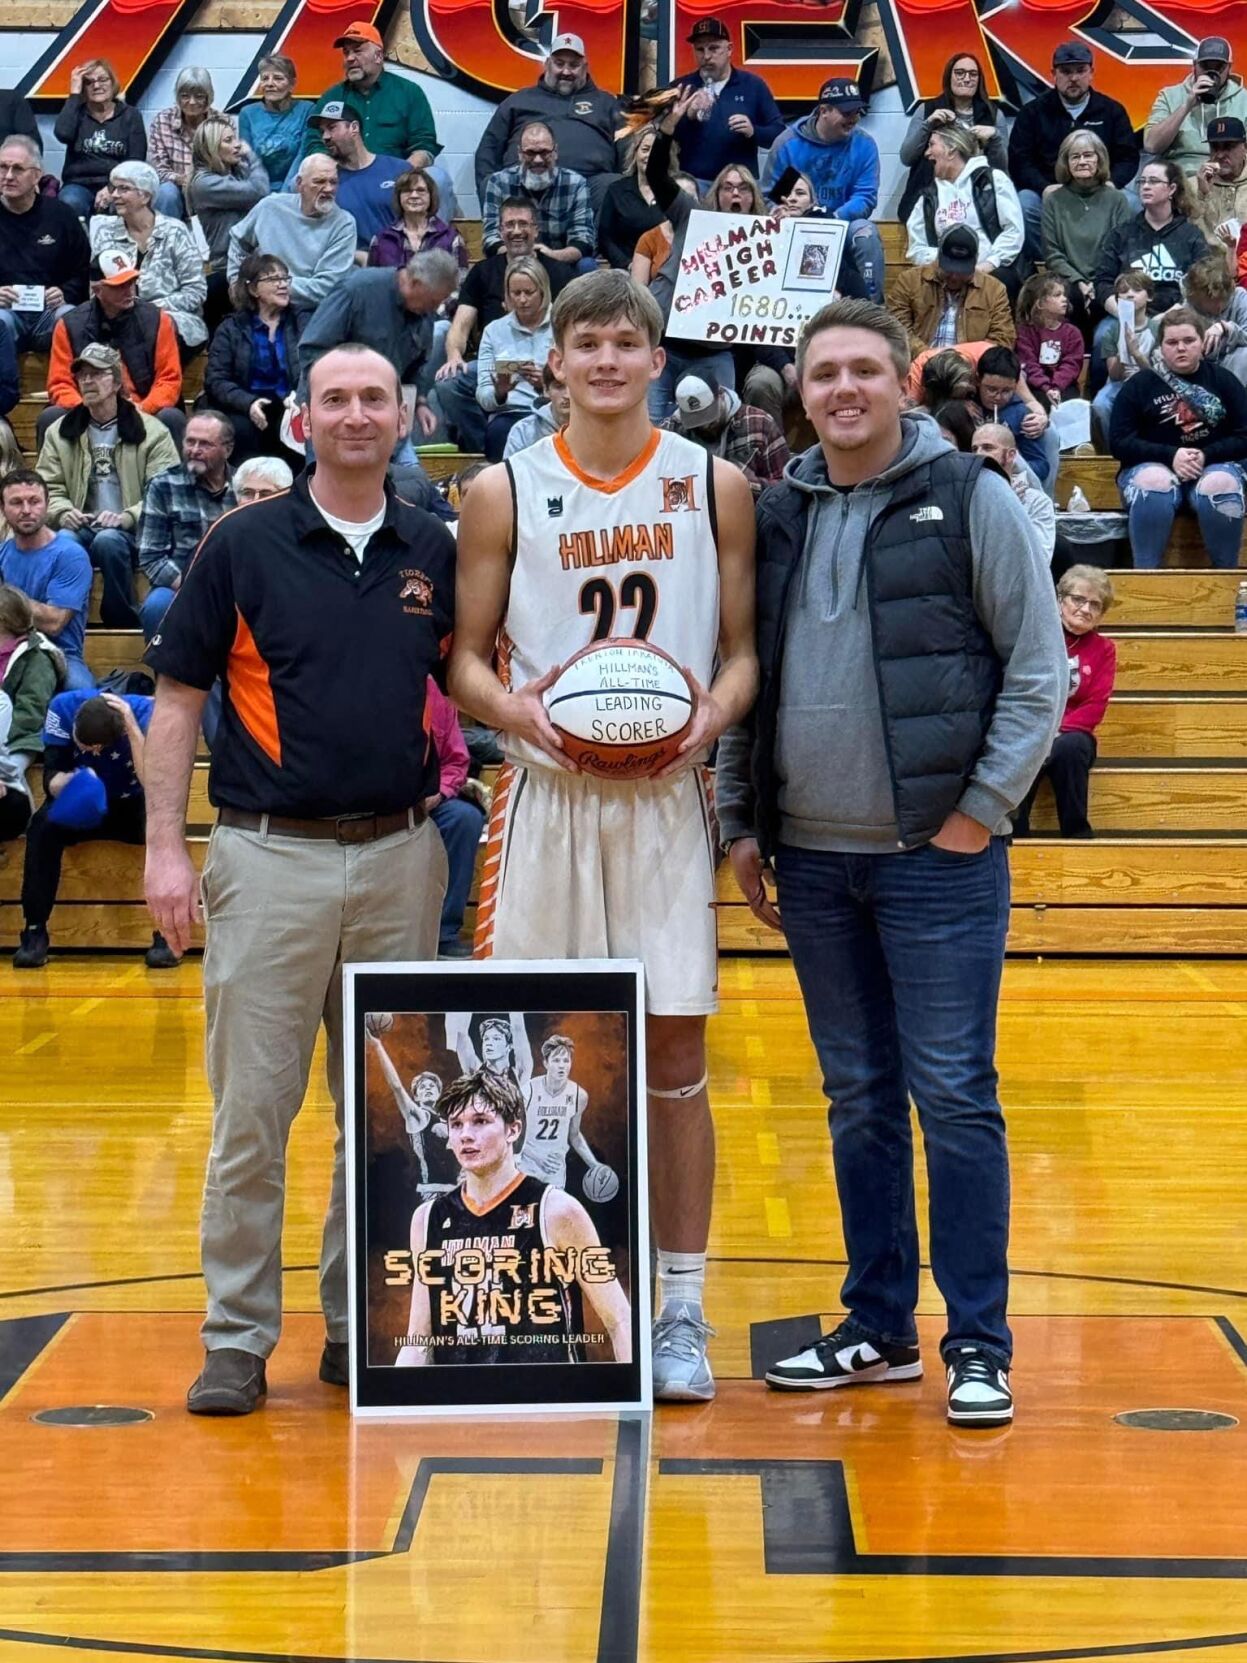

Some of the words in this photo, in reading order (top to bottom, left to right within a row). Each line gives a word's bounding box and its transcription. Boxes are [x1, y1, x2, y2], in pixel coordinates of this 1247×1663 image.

[681, 216, 783, 275] HILLMAN
[703, 239, 773, 280] HIGH
[674, 260, 777, 313] CAREER
[706, 322, 796, 345] POINTS
[559, 523, 674, 571] HILLMAN
[599, 663, 659, 677] HILLMAN'S
[599, 676, 662, 689] ALL-TIME
[595, 696, 662, 711] LEADING
[591, 718, 668, 742] SCORER
[535, 1118, 560, 1140] 22
[383, 1246, 616, 1287] SCORING
[439, 1287, 562, 1326] KING
[394, 1335, 455, 1347] HILLMAN'S
[456, 1334, 508, 1346] ALL-TIME
[509, 1333, 560, 1345] SCORING
[561, 1332, 605, 1344] LEADER
